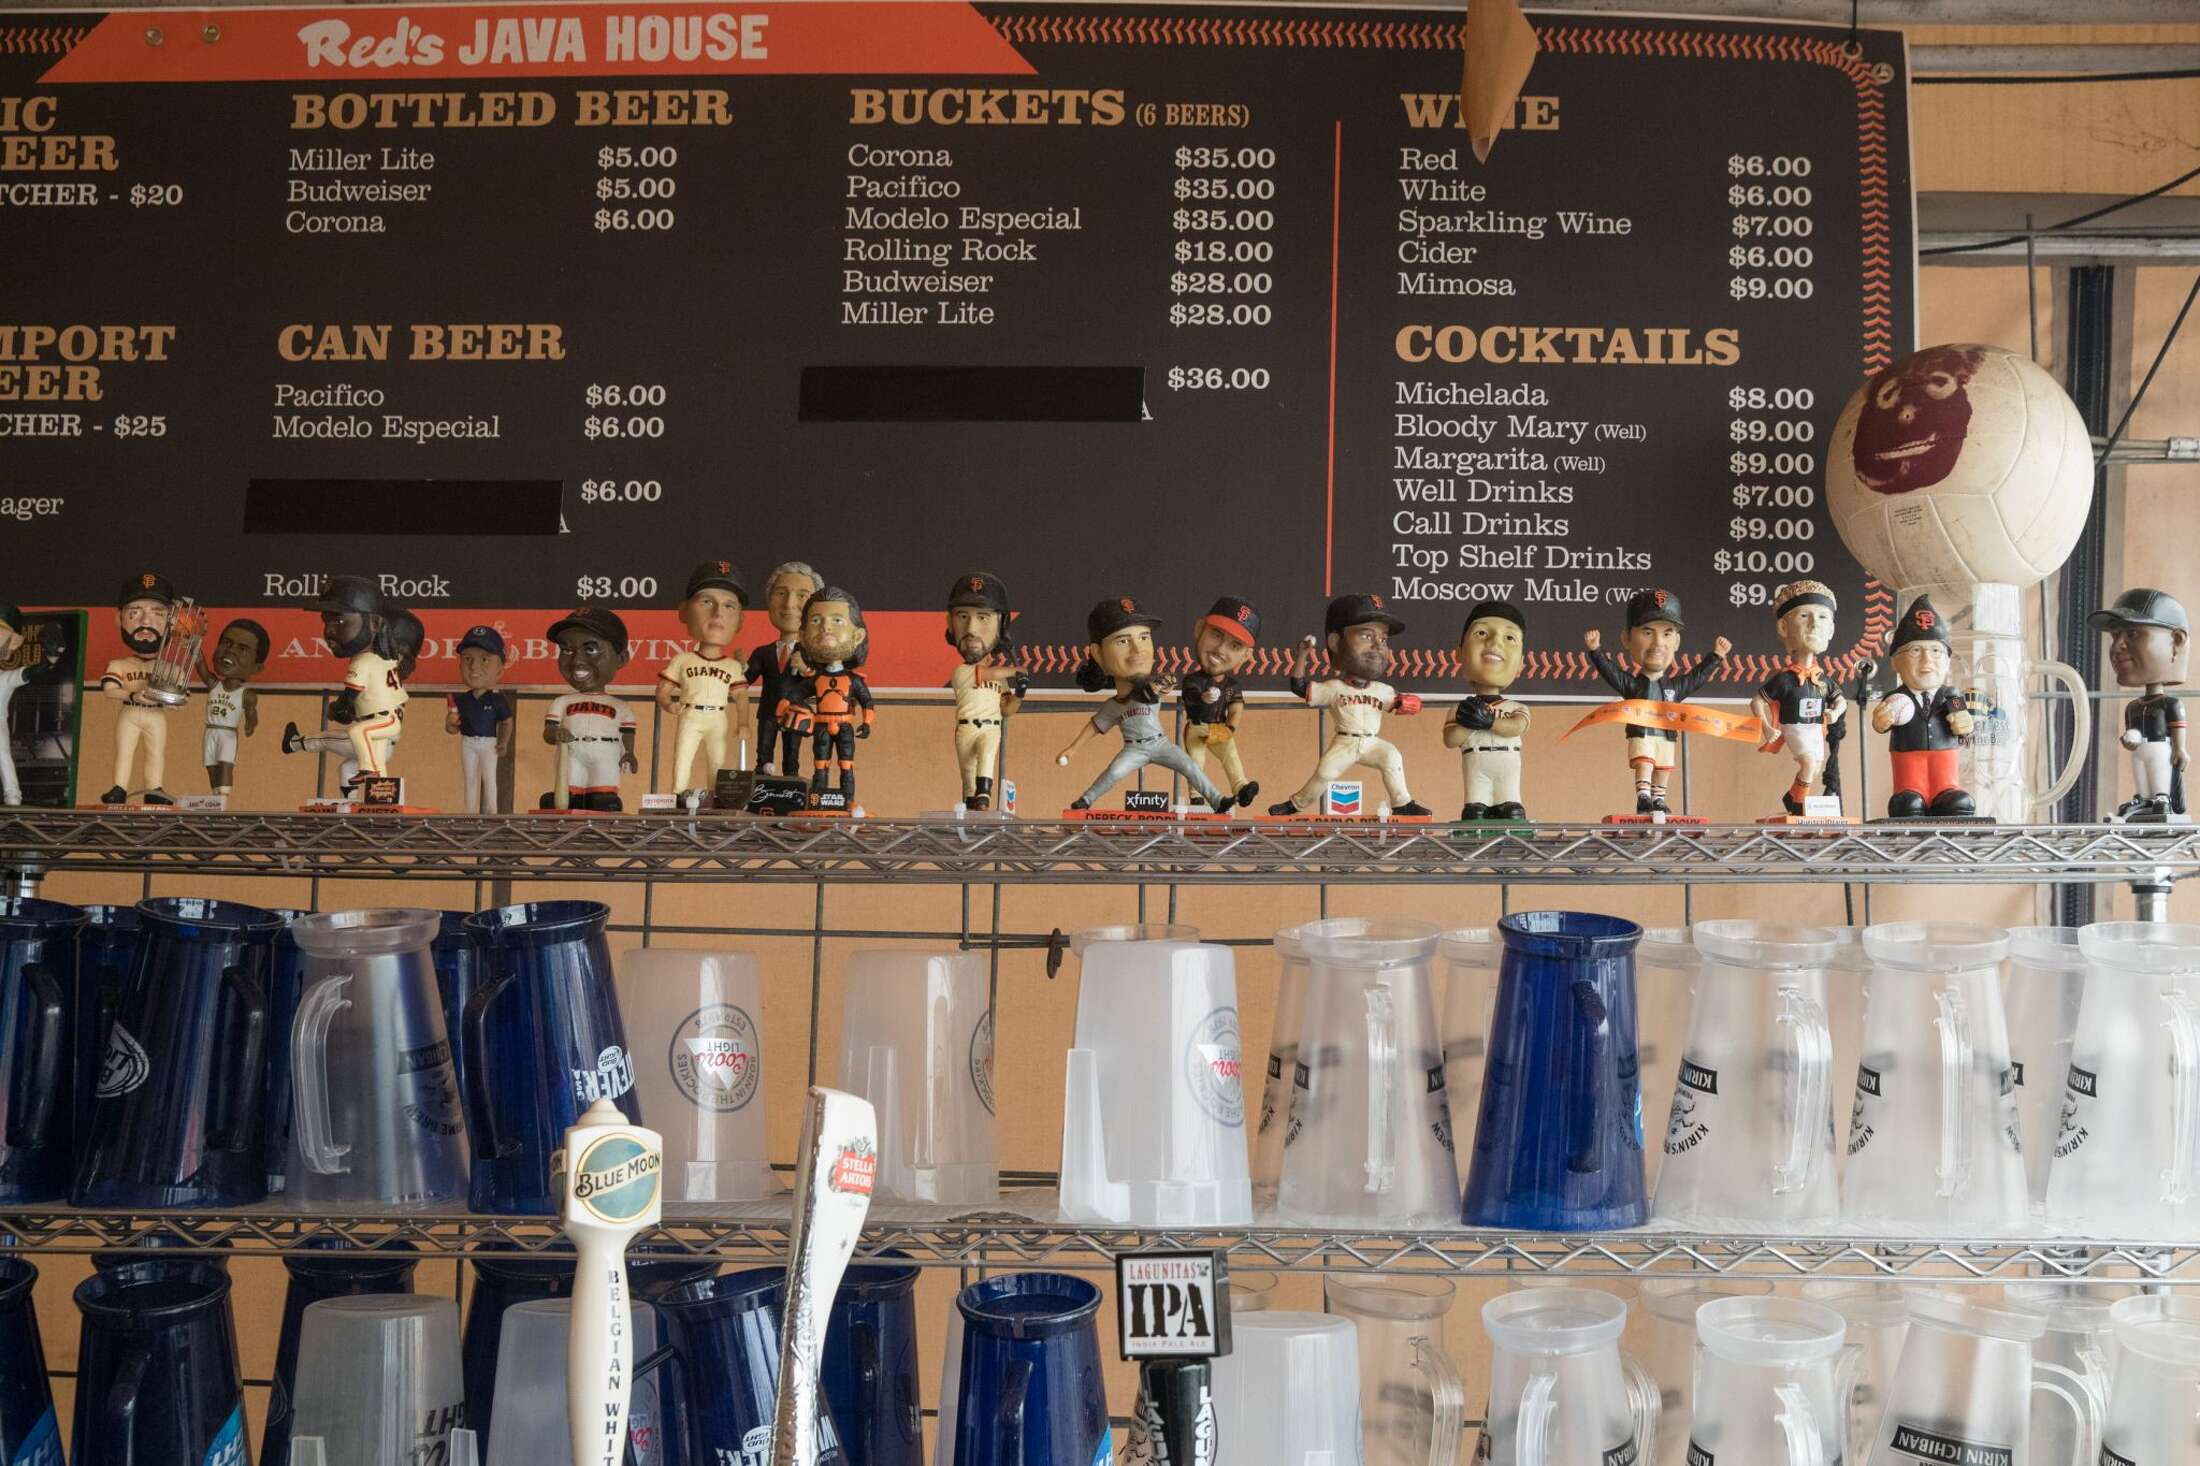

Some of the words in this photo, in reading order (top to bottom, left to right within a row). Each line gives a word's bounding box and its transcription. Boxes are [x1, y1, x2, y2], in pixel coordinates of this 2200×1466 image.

[298, 17, 444, 67] Red's
[459, 18, 586, 64] JAVA
[604, 13, 770, 62] HOUSE
[0, 97, 57, 132] IC
[291, 92, 556, 129] BOTTLED
[575, 90, 732, 125] BEER
[850, 88, 1125, 125] BUCKETS
[1136, 103, 1156, 127] (6
[1165, 104, 1249, 128] BEERS)
[1, 135, 120, 172] EER
[289, 148, 371, 171] Miller
[380, 148, 434, 170] Lite
[598, 145, 677, 170] $5.00
[848, 144, 952, 167] Corona
[1175, 145, 1275, 170] $35.00
[1400, 148, 1458, 170] Red
[1728, 154, 1811, 178] $6.00
[130, 184, 183, 208] $20
[288, 179, 431, 201] Budweiser
[596, 177, 675, 201] $5.00
[847, 175, 960, 198] Pacifico
[1174, 176, 1274, 201] $35.00
[1399, 179, 1486, 201] White
[1729, 184, 1812, 208] $6.00
[286, 211, 386, 233] Corona
[594, 208, 674, 232] $6.00
[845, 207, 948, 229] Modelo
[959, 207, 1082, 235] Especial
[1173, 208, 1273, 232] $35.00
[1399, 209, 1547, 239] Sparkling
[1556, 212, 1631, 235] Wine
[1732, 214, 1812, 238] $7.00
[844, 239, 952, 267] Rolling
[962, 239, 1037, 261] Rock
[1175, 239, 1273, 264] $18.00
[1398, 240, 1477, 263] Cider
[1729, 245, 1813, 269] $6.00
[843, 270, 993, 292] Budweiser
[1171, 270, 1272, 296] $28.00
[1398, 272, 1516, 295] Mimosa
[1730, 276, 1813, 301] $9.00
[841, 302, 928, 324] Miller
[938, 302, 994, 324] Lite
[1170, 302, 1271, 327] $28.00
[278, 325, 392, 361] CAN
[409, 324, 565, 360] BEER
[1396, 325, 1740, 365] COCKTAILS
[1168, 366, 1270, 391] $36.00
[275, 384, 384, 406] Pacifico
[586, 384, 666, 408] $6.00
[1395, 382, 1548, 406] Michelada
[1729, 386, 1814, 411] $8.00
[114, 414, 166, 439] $25
[273, 416, 372, 438] Modelo
[382, 416, 500, 444] Especial
[584, 415, 664, 440] $6.00
[1395, 414, 1497, 443] Bloody
[1507, 415, 1589, 444] Mary
[1595, 424, 1646, 442] (Well)
[1730, 418, 1814, 444] $9.00
[1394, 446, 1548, 476] Margarita
[1554, 456, 1605, 474] (Well)
[1730, 451, 1814, 476] $9.00
[581, 479, 661, 504] $6.00
[1393, 479, 1456, 502] Well
[1467, 479, 1573, 503] Drinks
[1733, 483, 1814, 509] $7.00
[0, 497, 64, 521] ager
[1393, 511, 1452, 534] Call
[1463, 512, 1569, 536] Drinks
[1730, 516, 1814, 542] $9.00
[1392, 544, 1448, 573] Top
[1460, 544, 1537, 568] Shelf
[1544, 546, 1651, 570] Drinks
[1714, 548, 1814, 574] $10.00
[377, 574, 450, 597] Rock
[577, 575, 657, 600] $3.00
[1392, 577, 1514, 600] Moscow
[1524, 578, 1598, 602] Mule
[127, 672, 154, 682] GIAN
[686, 666, 732, 684] GIANTS
[211, 706, 227, 717] 24
[1126, 793, 1168, 808] xfinity
[707, 1043, 740, 1053] LIGHT
[693, 1052, 749, 1075] Coors
[628, 1153, 660, 1179] MOON
[575, 1168, 624, 1198] BLUE
[1129, 1263, 1197, 1280] LAGUNITAS
[1128, 1283, 1211, 1337] IPA
[608, 1270, 621, 1390] BELGIAN
[1898, 1431, 1961, 1462] ICHIBAN
